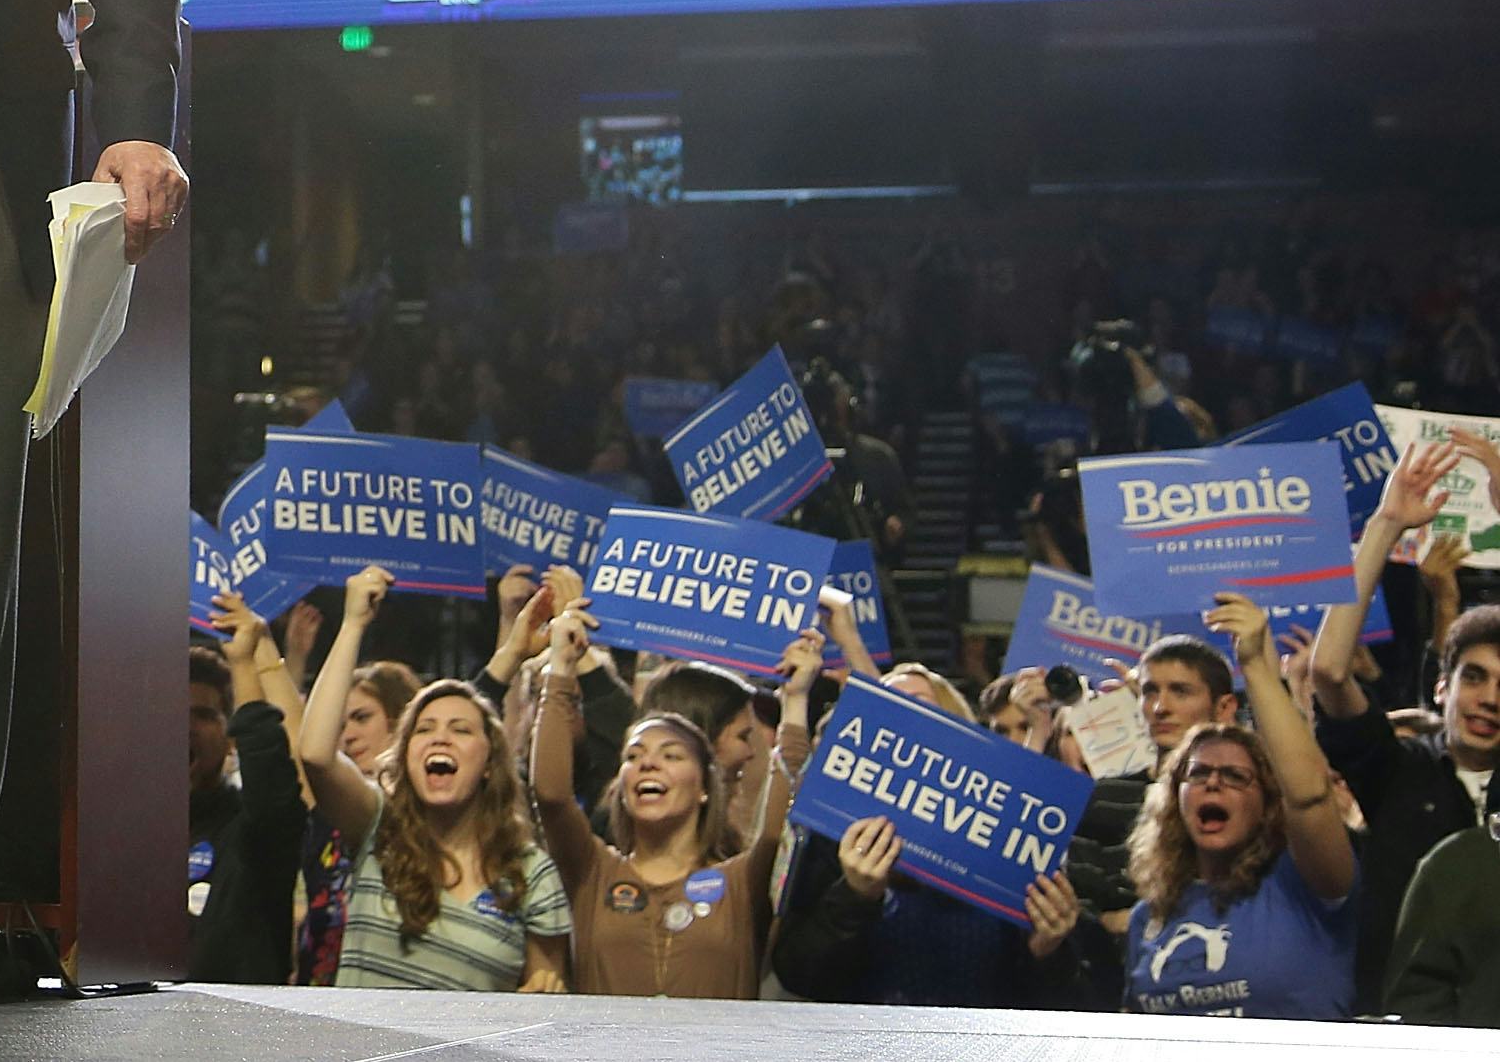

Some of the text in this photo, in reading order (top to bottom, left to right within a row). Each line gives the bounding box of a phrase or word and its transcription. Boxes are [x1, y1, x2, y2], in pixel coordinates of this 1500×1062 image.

[683, 382, 796, 486] A FUTURE TO
[690, 428, 787, 513] BELIEVE
[783, 407, 810, 446] IN
[1334, 420, 1379, 452] TO
[275, 467, 473, 509] A FUTURE TO
[1353, 446, 1397, 484] IN
[274, 500, 426, 540] BELIEVE
[436, 513, 476, 545] IN
[479, 478, 494, 499] A
[495, 482, 578, 533] FUTURE
[1118, 466, 1311, 526] Bernie
[193, 536, 228, 574] TO
[604, 538, 624, 562] A
[630, 540, 758, 585] FUTURE
[766, 562, 813, 596] TO
[1156, 534, 1284, 554] FOR PRESIDENT
[591, 564, 751, 619] BELIEVE
[756, 594, 805, 632] IN
[1049, 590, 1163, 651] Berni
[838, 716, 1068, 836] A FUTURE TO
[822, 744, 1056, 874] BELIEVE IN
